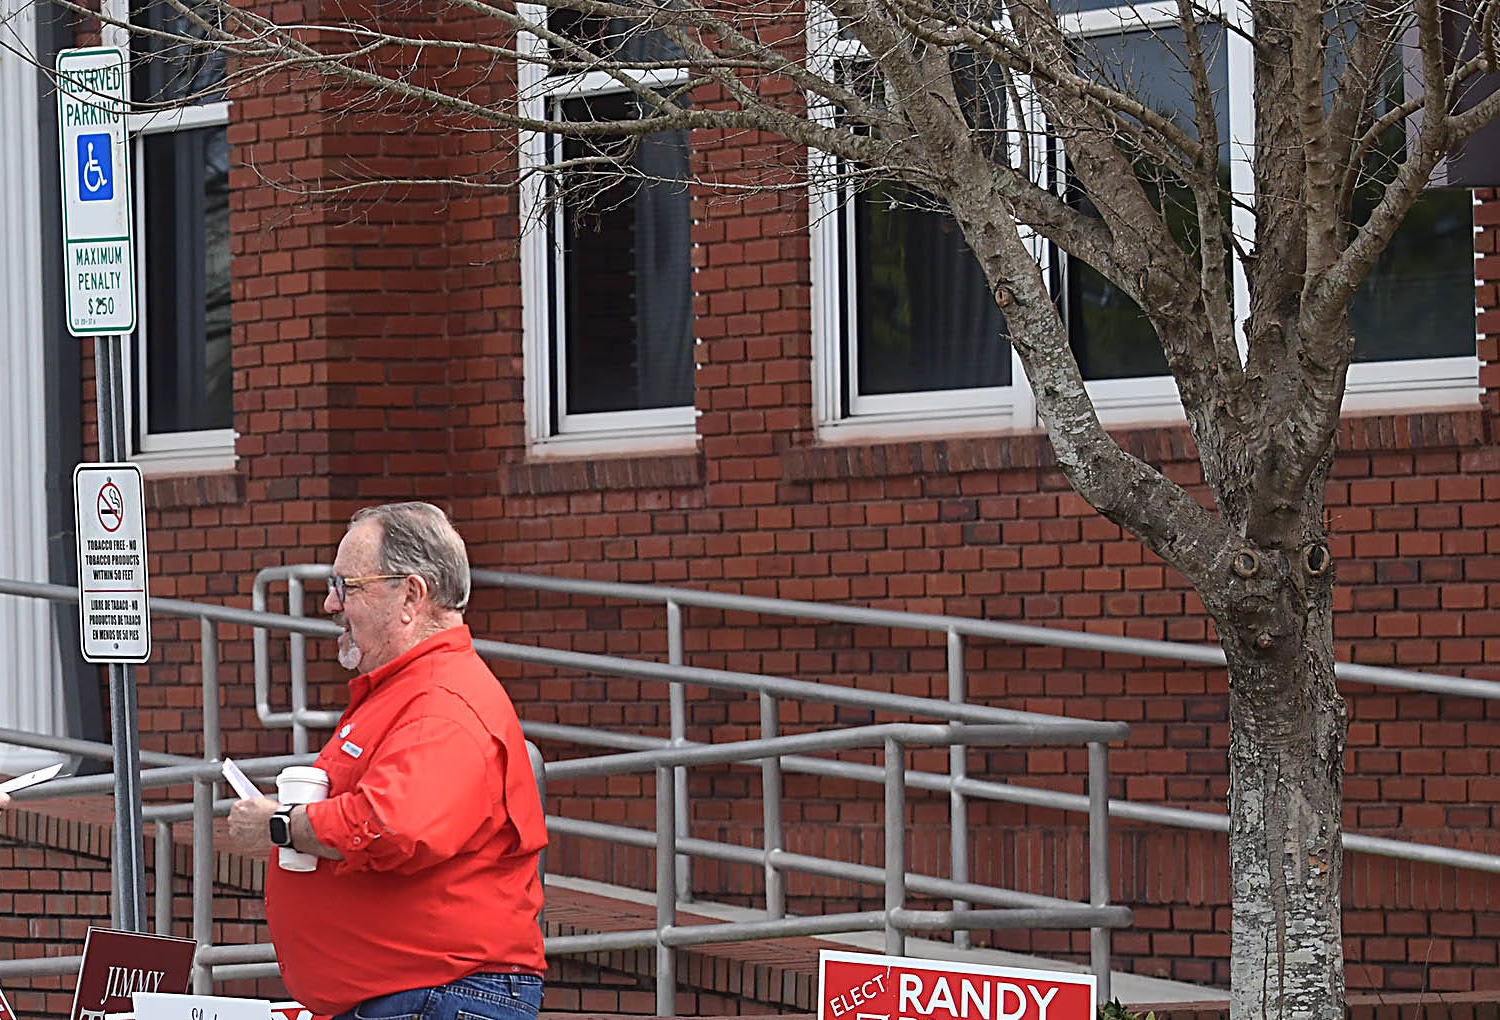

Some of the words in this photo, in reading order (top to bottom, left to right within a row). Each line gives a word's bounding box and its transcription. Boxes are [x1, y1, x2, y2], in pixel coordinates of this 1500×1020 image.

[62, 67, 120, 93] RESERVED
[66, 102, 120, 127] PARKING
[76, 247, 122, 266] MAXIMUM
[78, 272, 121, 290] PENALTY
[88, 298, 114, 315] $250
[87, 540, 112, 550] TOBACCO
[113, 540, 125, 550] FREE
[129, 540, 137, 550] NO
[85, 555, 111, 565] TOBACCO
[112, 555, 139, 565] PRODUCTS
[93, 570, 113, 580] WITHIN
[114, 570, 121, 580] 50
[122, 570, 133, 580] FEET
[105, 600, 110, 610] DE
[118, 615, 123, 625] DE
[129, 630, 139, 640] PIES
[101, 966, 164, 1005] JIMMY
[829, 974, 886, 1018] ELECT
